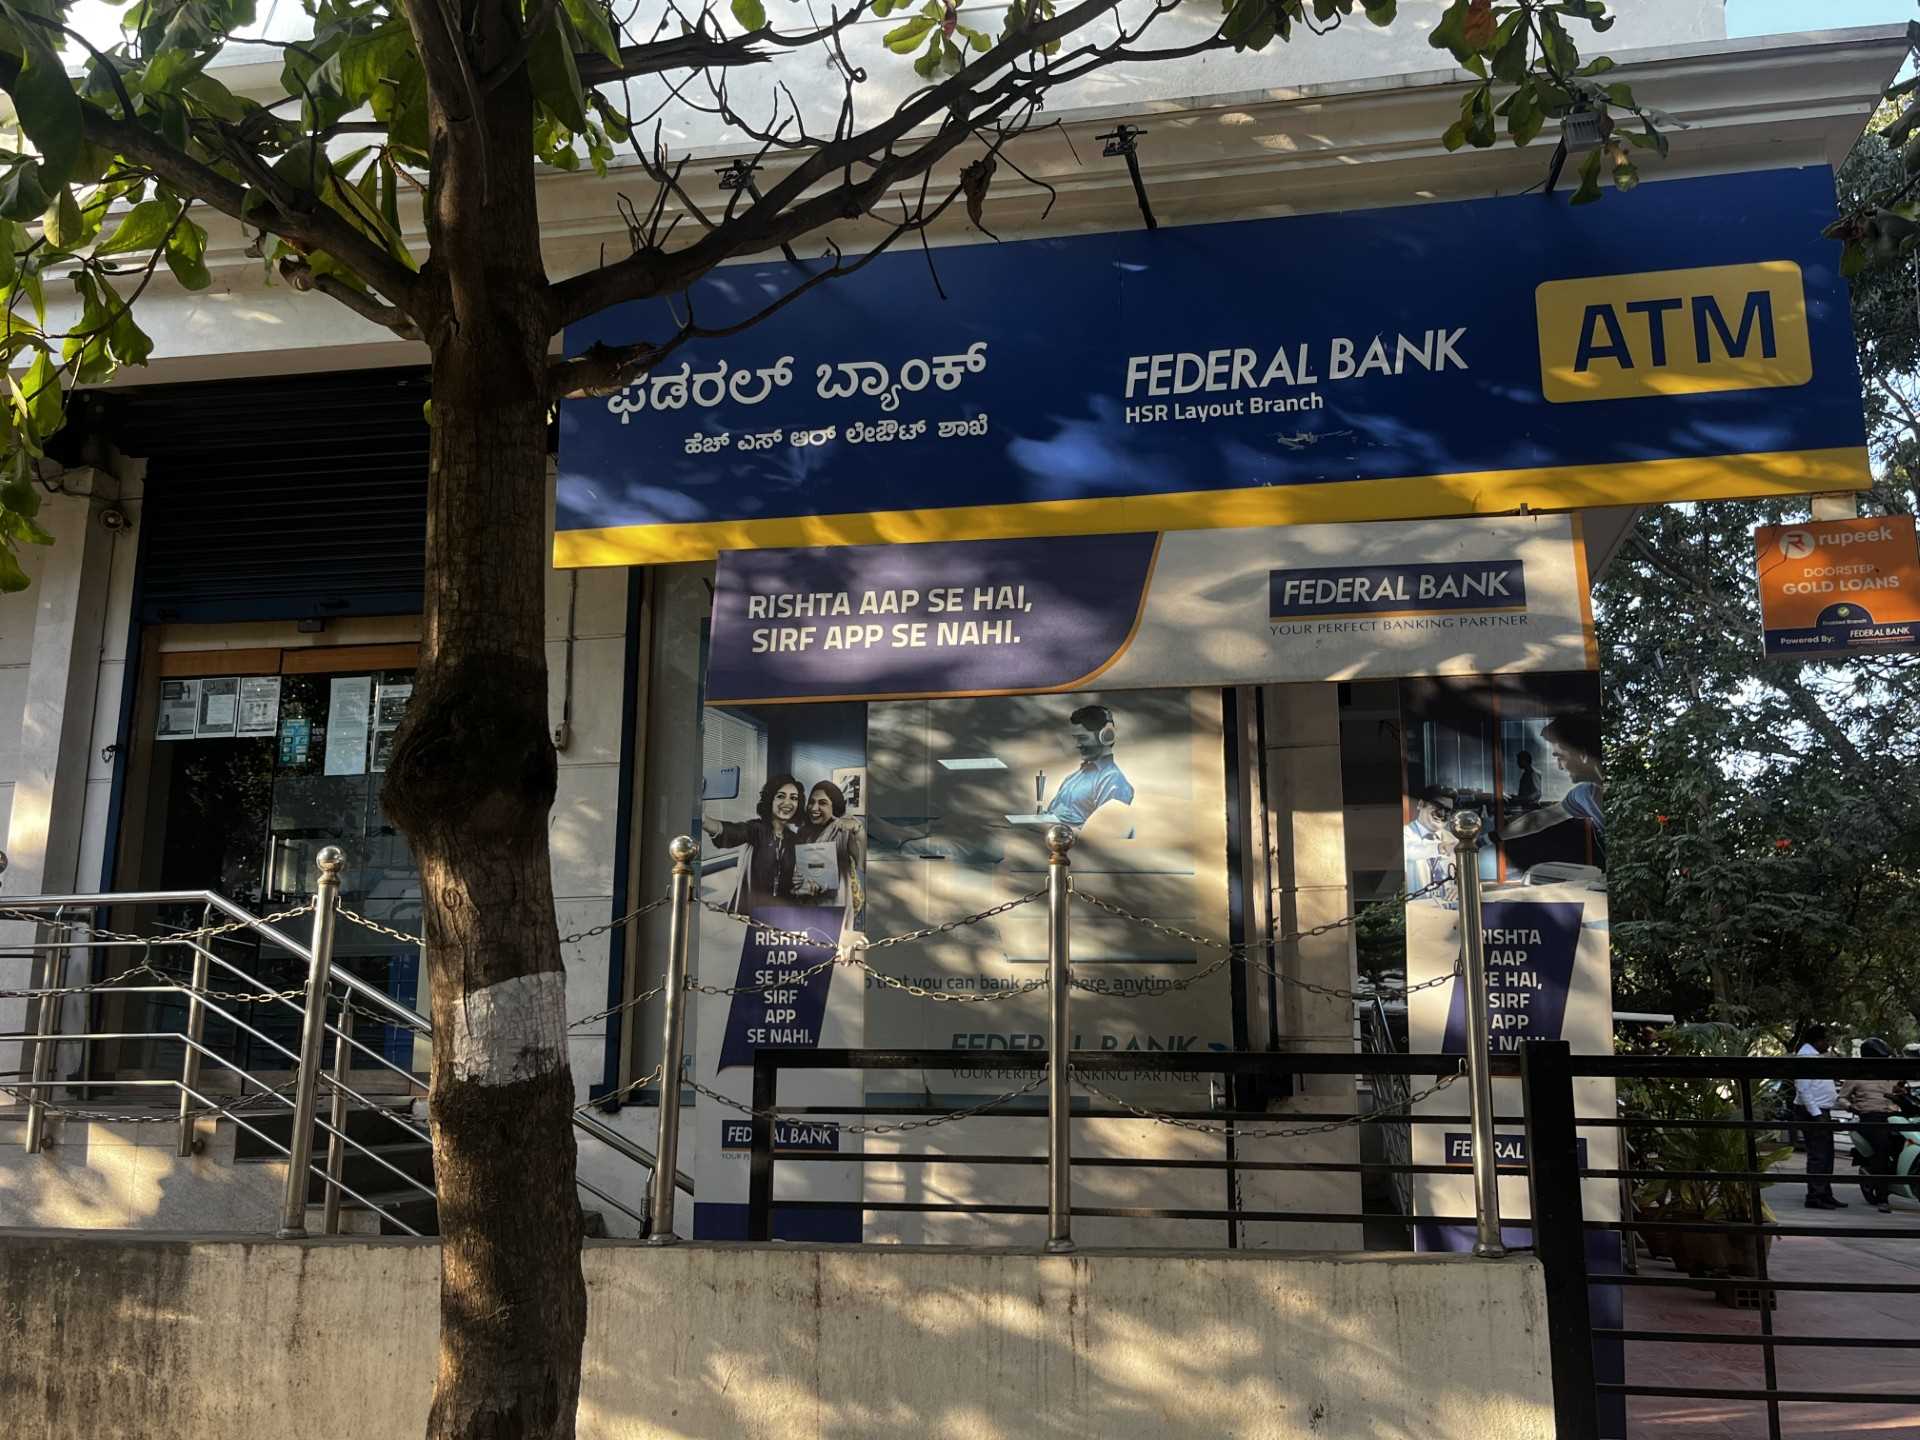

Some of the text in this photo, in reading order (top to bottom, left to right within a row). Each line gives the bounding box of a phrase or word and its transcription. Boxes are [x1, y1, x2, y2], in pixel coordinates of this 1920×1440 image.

[1573, 289, 1777, 373] ATM
[1125, 327, 1469, 398] FEDERAL BANK
[816, 341, 988, 412] ಬ್ಯಾಂಕ್
[1125, 391, 1324, 424] HSR Layout Branch
[738, 428, 782, 451] ಎಸ್
[790, 425, 836, 447] ಆರ್
[938, 413, 989, 438] ಶಾಖೆ
[1819, 526, 1894, 546] rupeek
[1804, 564, 1875, 577] DOORSTEP
[1283, 570, 1511, 605] FEDERAL BANK
[1782, 576, 1900, 595] GOLD LOANS
[748, 585, 1032, 619] RISHTA AAP SE HAI,
[1270, 615, 1529, 636] YOUR PERFECT BANKING PARTNER
[1850, 626, 1911, 639] FEDERAL BANK
[751, 620, 1021, 653] SIRF APP SE NAHI.
[1780, 634, 1819, 645] Powered
[755, 931, 810, 946] RISHTA
[766, 951, 798, 965] AAP
[1490, 950, 1527, 966] AAP
[755, 970, 774, 985] SE
[913, 977, 942, 992] you
[946, 977, 975, 989] can
[980, 974, 1018, 989] bank
[1505, 971, 1542, 990] HAI,
[764, 990, 798, 1004] SIRF
[1489, 993, 1530, 1008] SIRF
[765, 1009, 796, 1023] APP
[1491, 1014, 1529, 1029] APP
[747, 1028, 813, 1043] SE NAHI.
[952, 1065, 1200, 1082] YOUR PERFEC ANKING PARTNER
[728, 1126, 832, 1145] FEDAL BANK
[1452, 1140, 1525, 1159] FERAL
